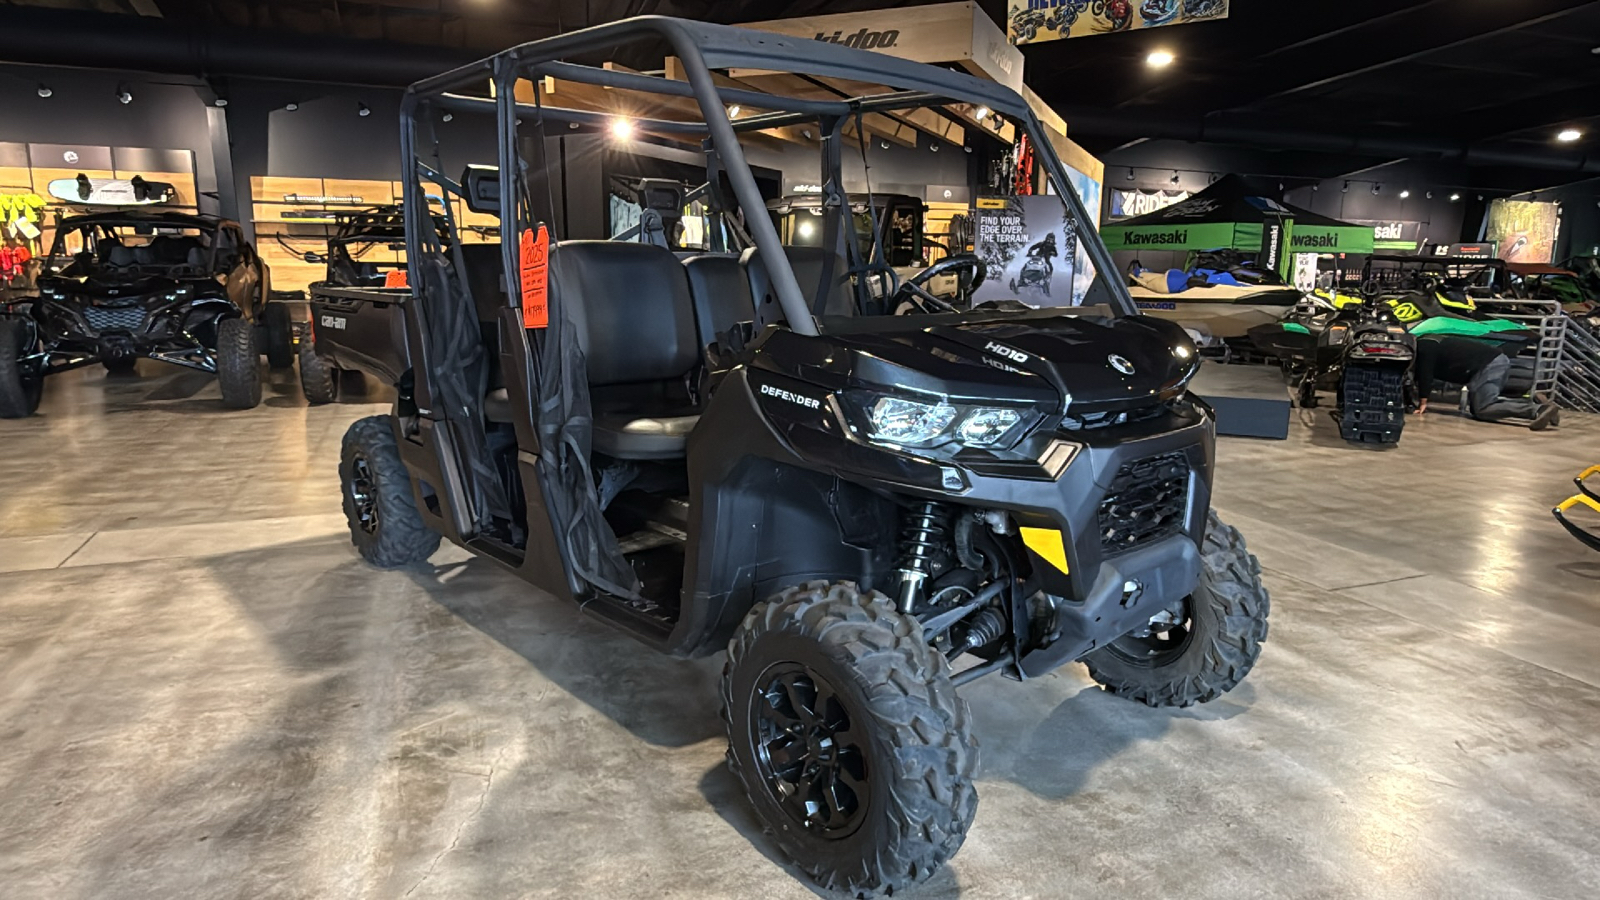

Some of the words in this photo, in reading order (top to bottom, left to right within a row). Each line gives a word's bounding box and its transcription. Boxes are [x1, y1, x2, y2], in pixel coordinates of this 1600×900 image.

[980, 216, 998, 226] FIND
[1000, 216, 1021, 226] YOUR
[980, 225, 999, 234] EDGE
[1001, 225, 1022, 234] OVER
[1123, 229, 1188, 245] Kawasaki
[1374, 223, 1402, 239] saki
[980, 233, 994, 243] THE
[996, 233, 1031, 243] TERRAIN.
[1290, 232, 1339, 248] wasaki
[525, 243, 544, 265] 2025
[1266, 225, 1279, 271] Kawasaki
[321, 315, 347, 331] can-am
[984, 341, 1029, 363] HD10
[760, 384, 820, 409] DEFENDER
